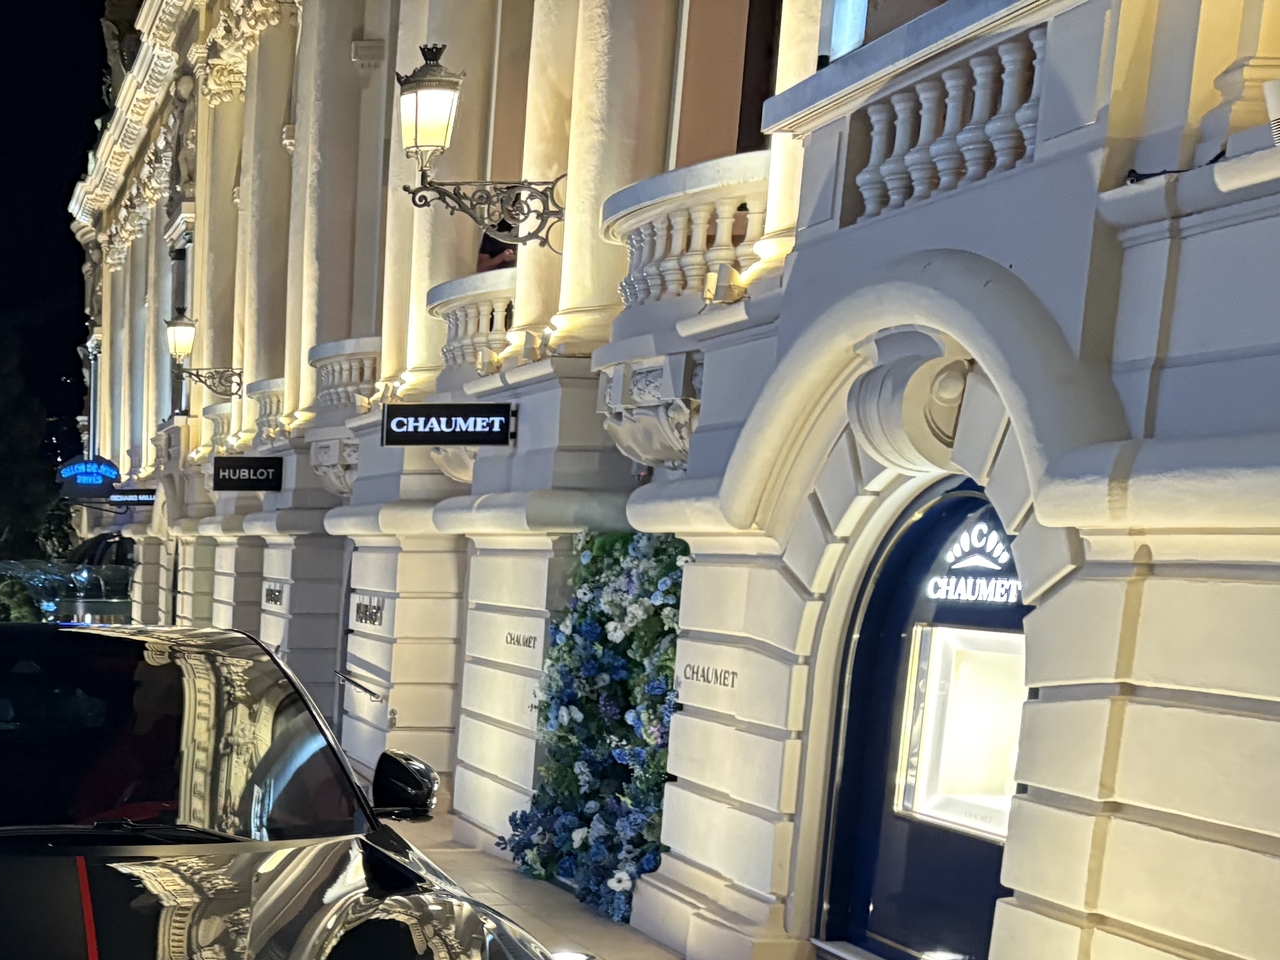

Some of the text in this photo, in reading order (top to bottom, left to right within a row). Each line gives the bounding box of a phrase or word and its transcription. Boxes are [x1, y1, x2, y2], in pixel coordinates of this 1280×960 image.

[390, 416, 506, 433] CHAUMET
[219, 468, 276, 480] HUBLOT
[926, 575, 1022, 603] CHAUMET
[505, 631, 538, 650] CHAUMET
[683, 663, 738, 689] CHAUMET
